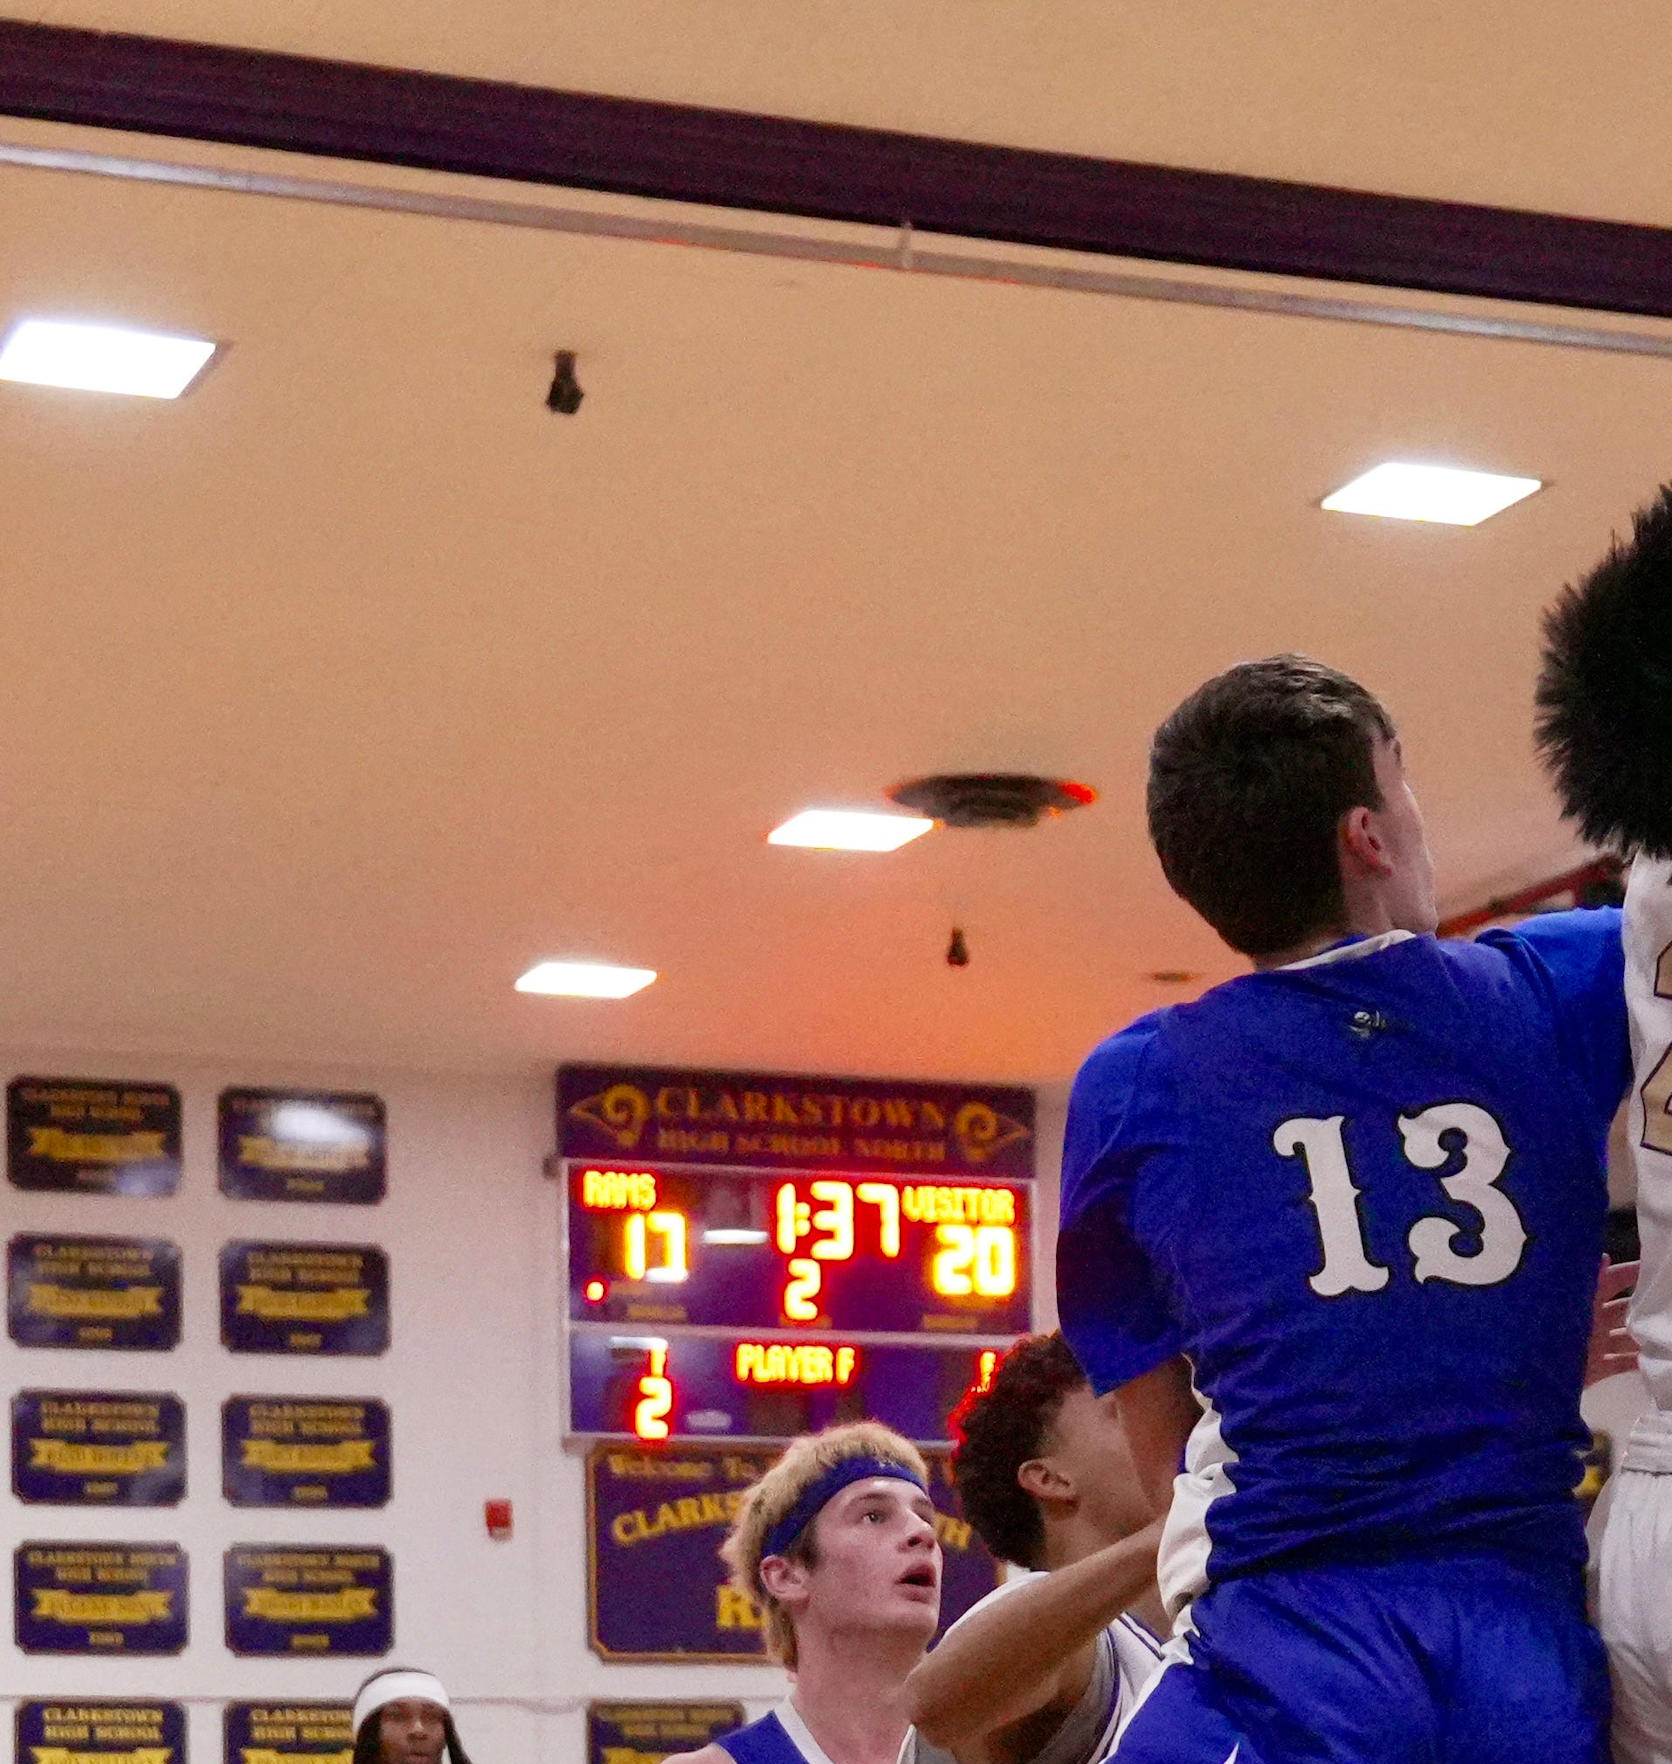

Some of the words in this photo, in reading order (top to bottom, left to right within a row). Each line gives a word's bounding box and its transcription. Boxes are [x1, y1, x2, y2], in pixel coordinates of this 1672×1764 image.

[656, 1086, 946, 1129] CLARKSTOWN
[777, 1181, 900, 1259] 1:37
[1273, 1102, 1529, 1297] 13
[784, 1257, 822, 1321] 2
[933, 1224, 1016, 1297] 20
[635, 1376, 672, 1440] 2
[612, 1488, 748, 1544] CLARKS
